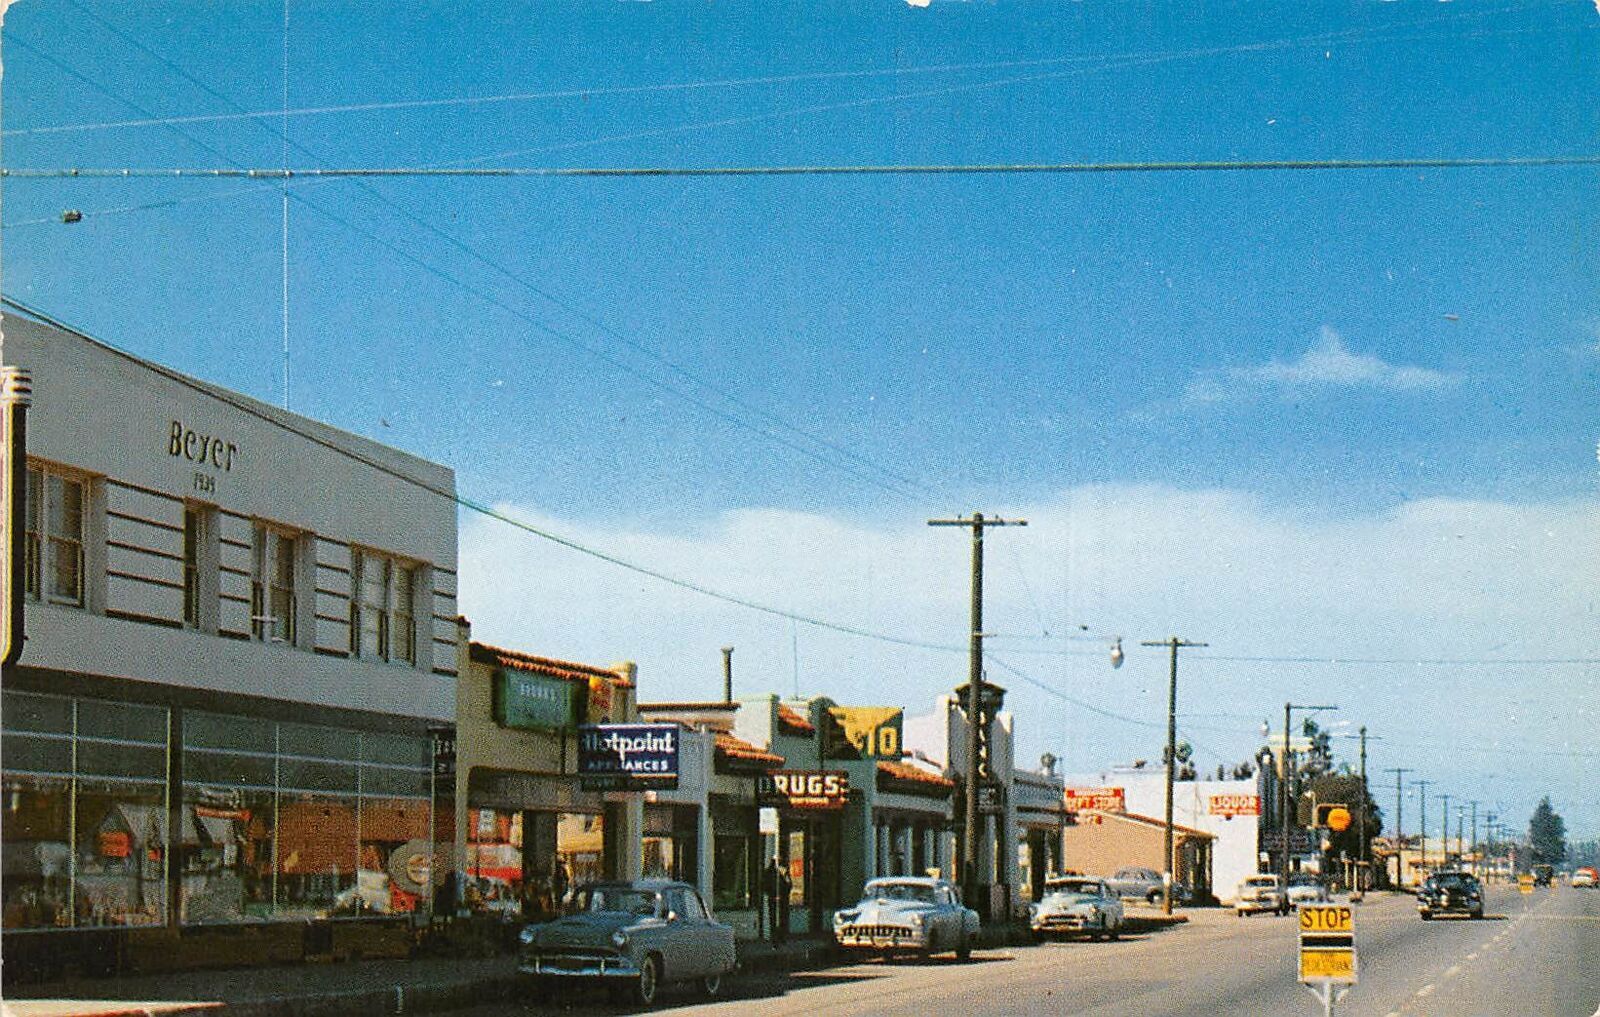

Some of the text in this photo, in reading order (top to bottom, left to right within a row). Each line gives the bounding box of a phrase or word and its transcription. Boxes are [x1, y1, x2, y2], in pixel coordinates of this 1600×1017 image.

[169, 420, 237, 471] Beyer
[585, 731, 676, 761] Hotpoint
[759, 774, 840, 796] DRUGS
[1300, 906, 1351, 928] STOP
